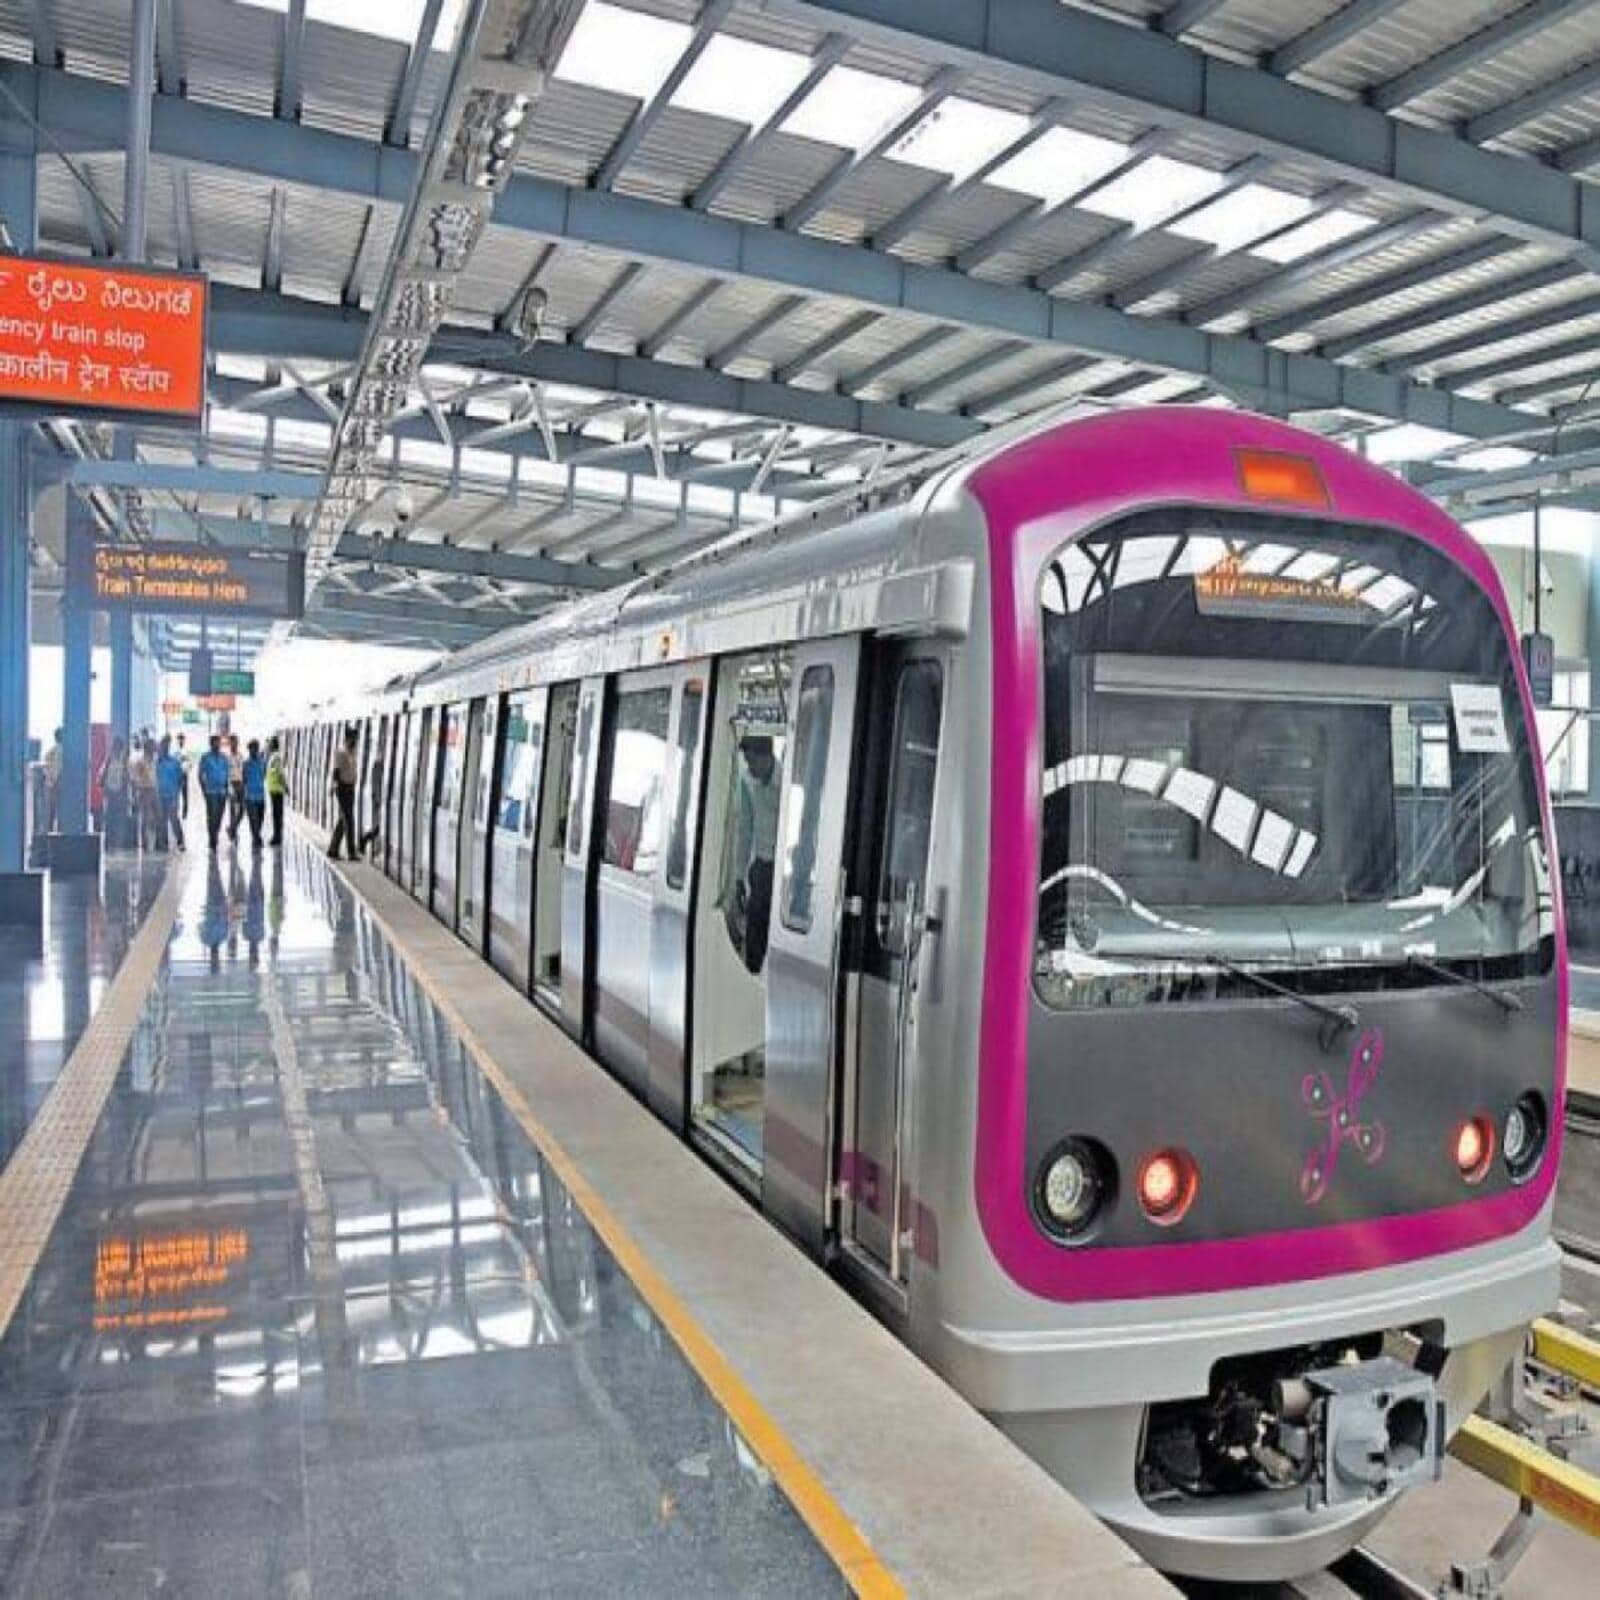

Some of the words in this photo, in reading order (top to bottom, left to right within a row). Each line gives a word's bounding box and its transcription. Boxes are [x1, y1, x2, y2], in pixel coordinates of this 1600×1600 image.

[51, 321, 97, 345] train
[78, 354, 109, 393] ट्रेन
[119, 363, 171, 393] स्टॉप
